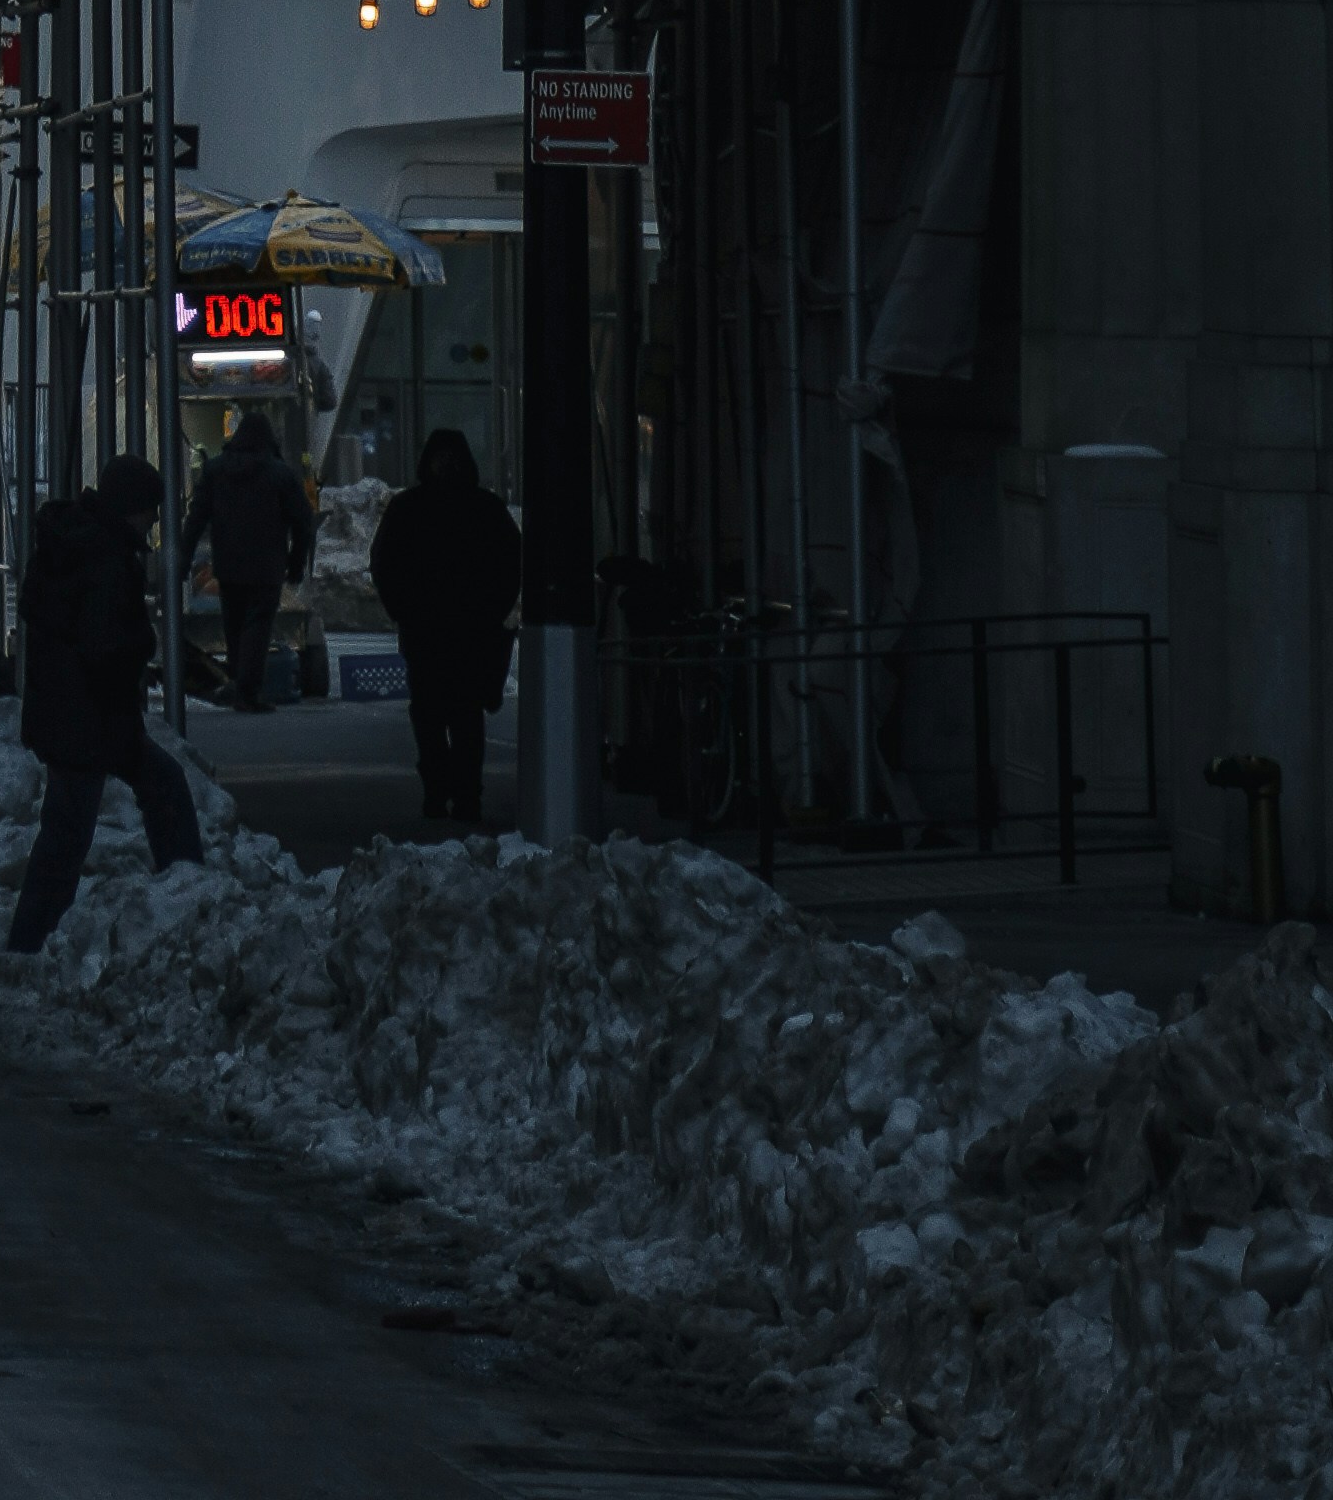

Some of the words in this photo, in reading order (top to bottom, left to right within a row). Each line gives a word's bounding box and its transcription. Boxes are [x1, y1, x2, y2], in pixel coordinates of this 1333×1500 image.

[538, 80, 558, 98] NO
[562, 81, 633, 100] STANDING
[539, 102, 597, 123] Anytime
[205, 293, 284, 338] DOG
